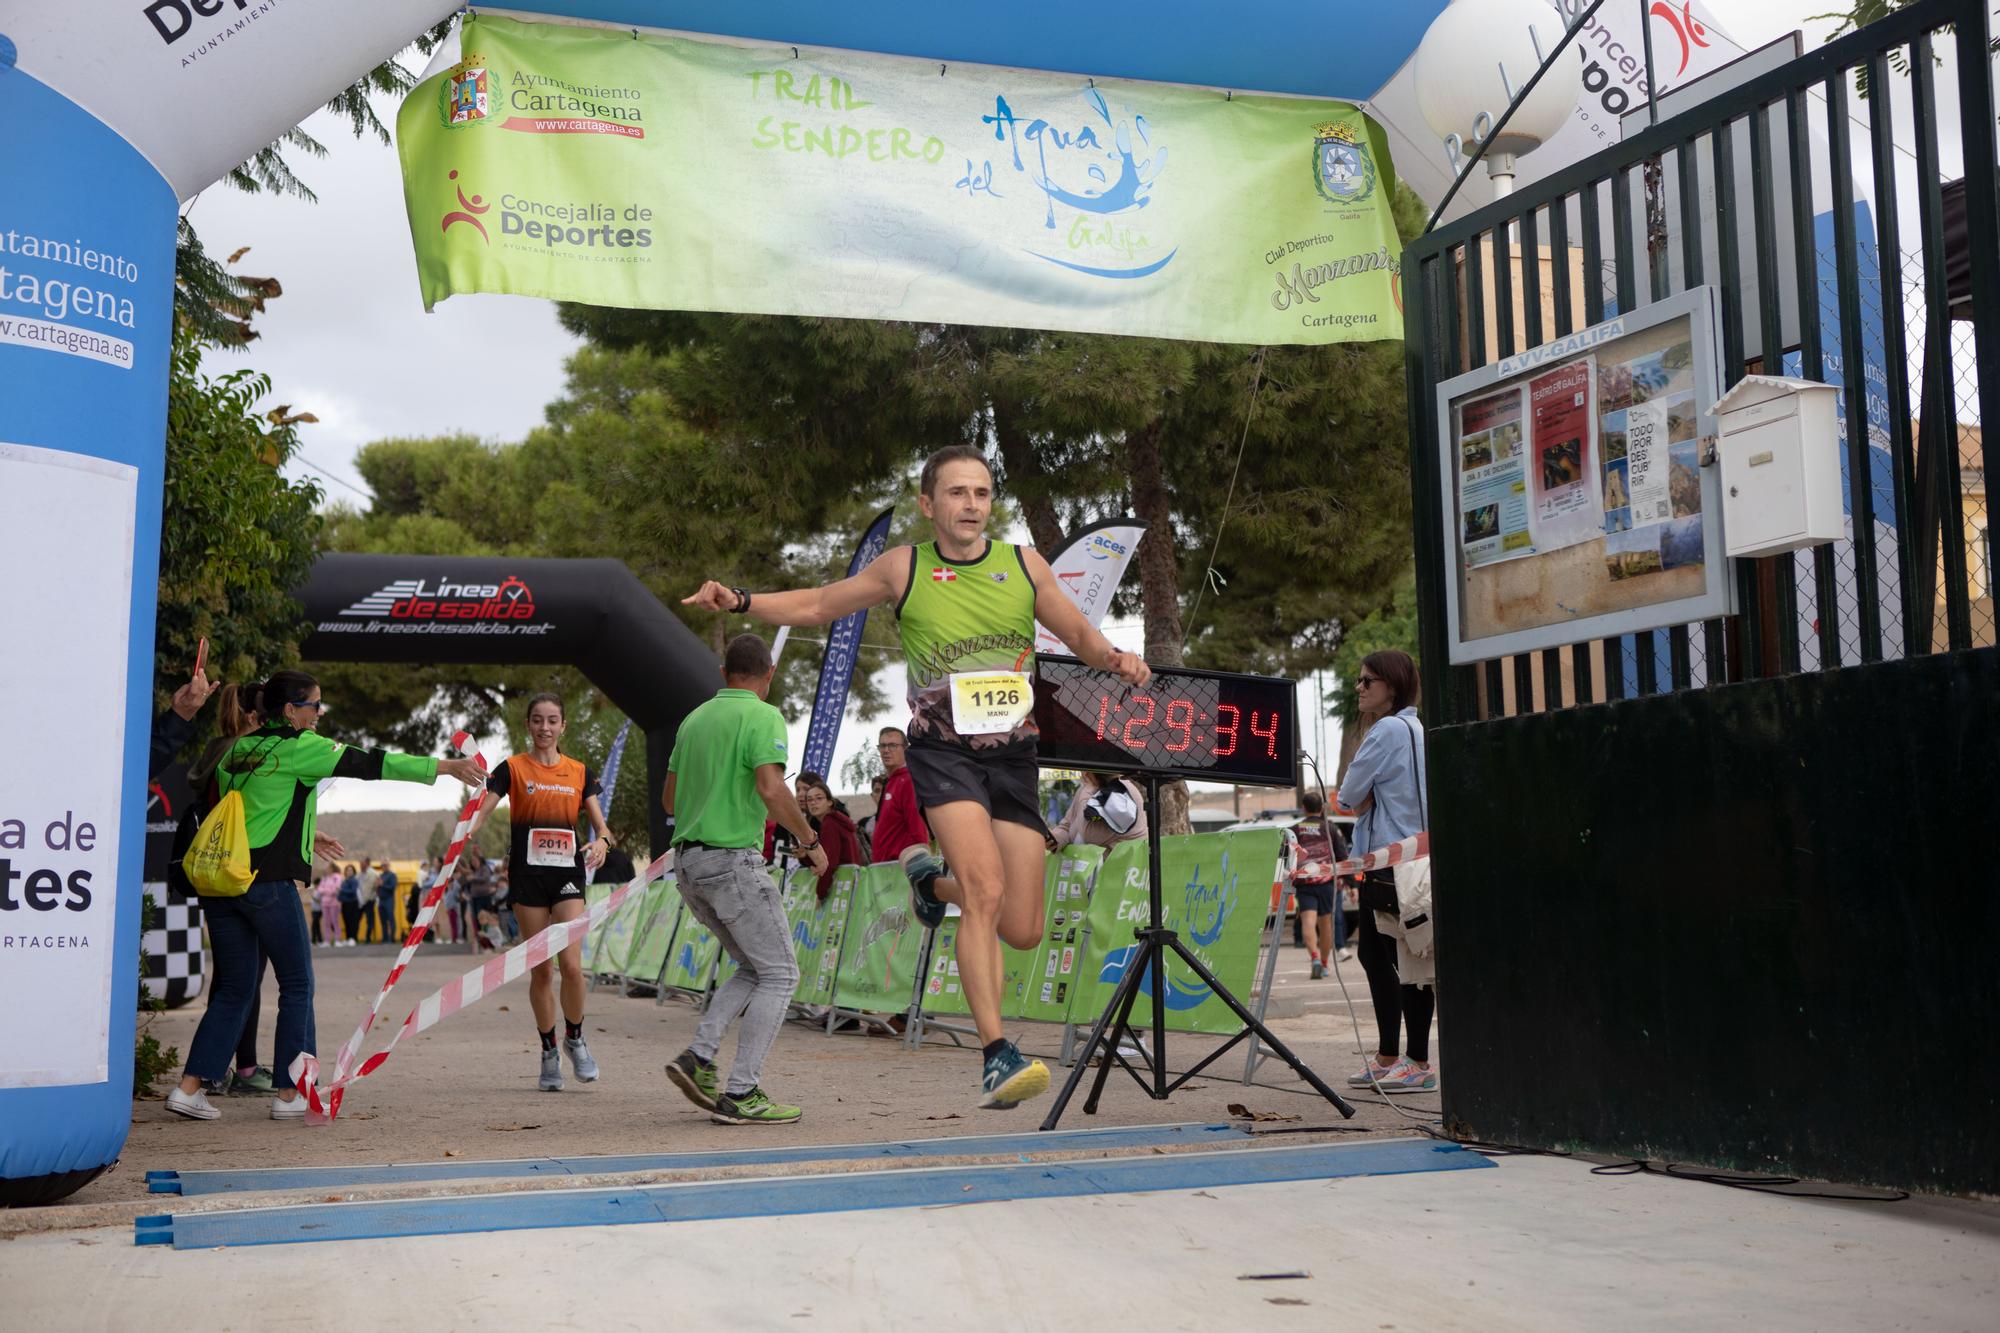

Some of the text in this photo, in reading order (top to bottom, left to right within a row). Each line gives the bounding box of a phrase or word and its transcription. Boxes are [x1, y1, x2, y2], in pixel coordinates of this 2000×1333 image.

[181, 0, 284, 68] AYUNTAMIENT
[511, 71, 641, 100] Ayuntamiento
[744, 69, 876, 111] TRAIL
[511, 89, 642, 121] Cartagena
[535, 119, 640, 136] www.cartagena.es
[751, 115, 946, 164] SENDERO
[955, 95, 1103, 229] del Agua
[501, 194, 652, 223] Concejalía de
[501, 211, 652, 248] Deportes
[1067, 214, 1150, 260] Galifa
[503, 243, 574, 261] AYUNTAMIENTO
[595, 254, 652, 263] CARTAGENA
[1265, 233, 1334, 265] Club Deportivo
[1302, 313, 1378, 329] Cartagena
[1532, 386, 1553, 401] TEATRO
[1562, 374, 1587, 389] GALIFA
[1094, 535, 1127, 555] aces
[1089, 573, 1104, 605] 2022
[317, 621, 555, 634] www.lineadesalida.net
[811, 611, 858, 781] artagen
[971, 690, 1019, 706] 1126
[1097, 696, 1278, 758] 1:29:34
[45, 811, 96, 851] de
[538, 839, 568, 850] 2011
[0, 859, 92, 912] tes
[4, 936, 89, 948] RTAGENA
